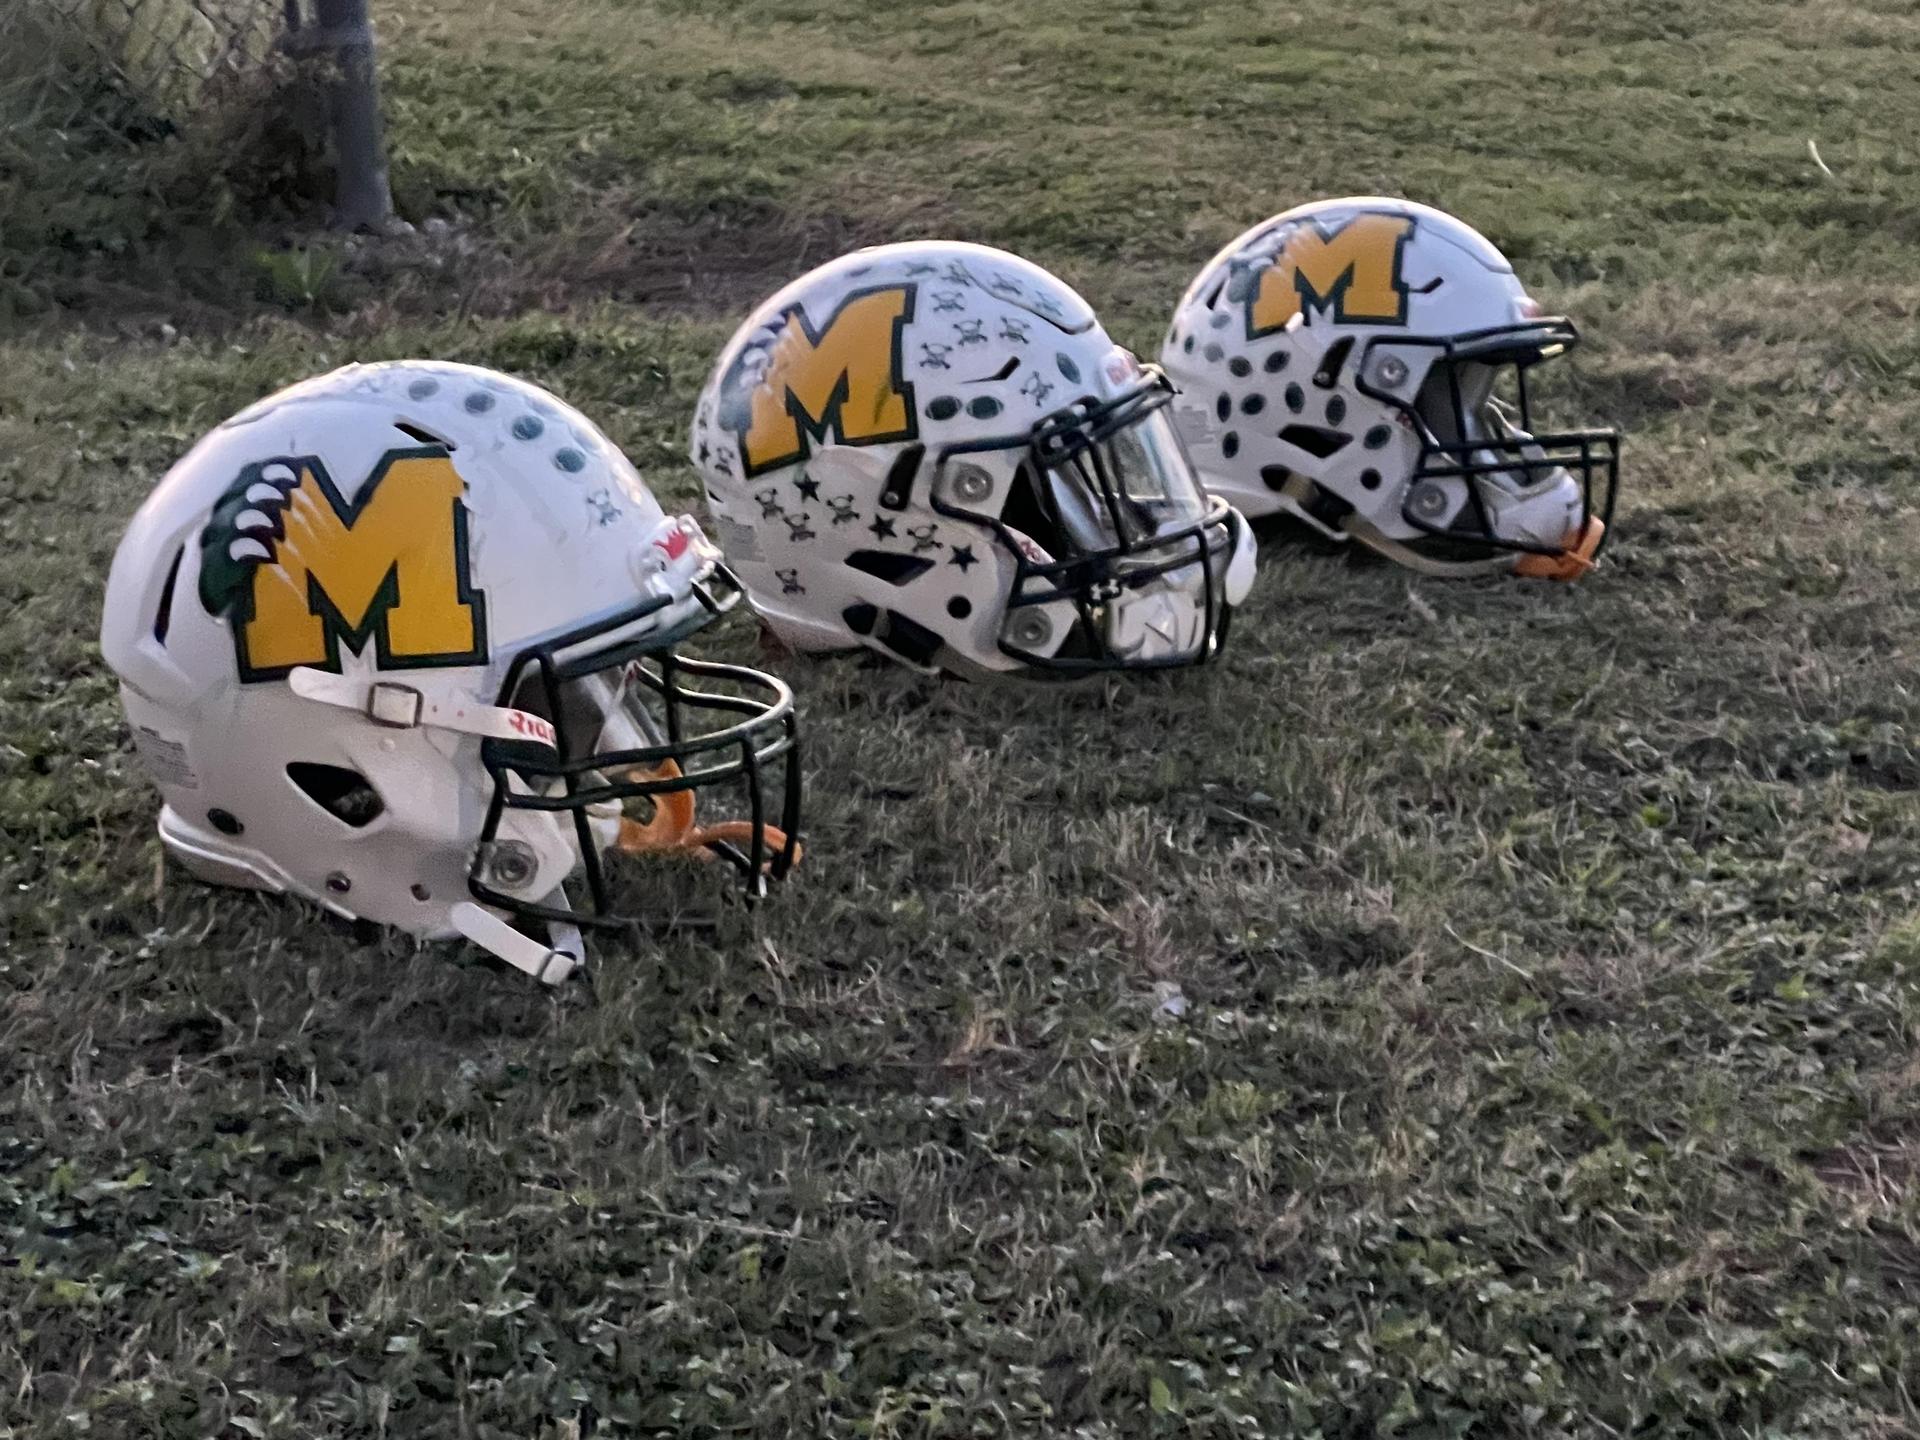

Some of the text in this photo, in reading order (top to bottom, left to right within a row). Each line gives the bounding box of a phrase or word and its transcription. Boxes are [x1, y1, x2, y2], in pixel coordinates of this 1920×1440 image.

[1245, 210, 1418, 342] M
[737, 281, 919, 480] M
[232, 445, 490, 684] M
